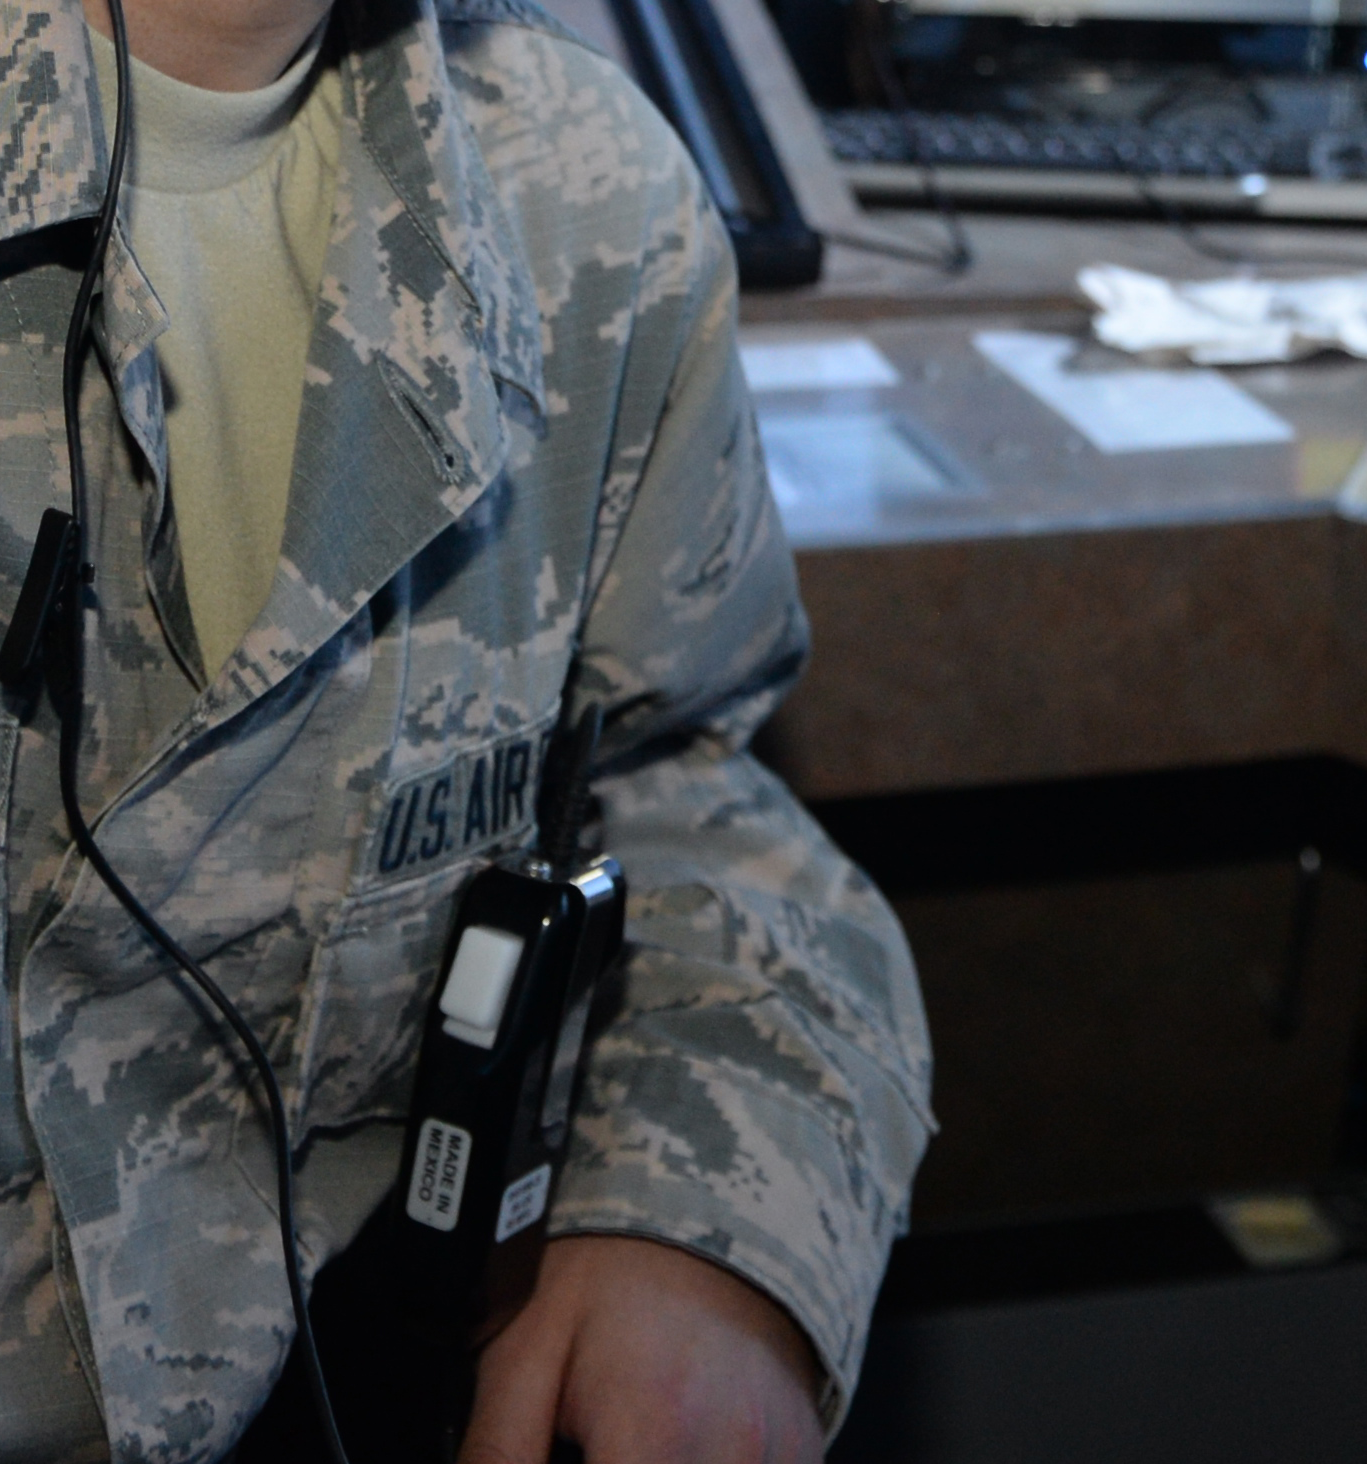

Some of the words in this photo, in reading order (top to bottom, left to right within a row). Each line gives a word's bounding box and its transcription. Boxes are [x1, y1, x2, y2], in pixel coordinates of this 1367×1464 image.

[379, 774, 453, 874] U.S.
[463, 740, 531, 845] AIR
[418, 1126, 445, 1203] MEXICO
[440, 1133, 463, 1192] MADE
[436, 1193, 451, 1215] IN
